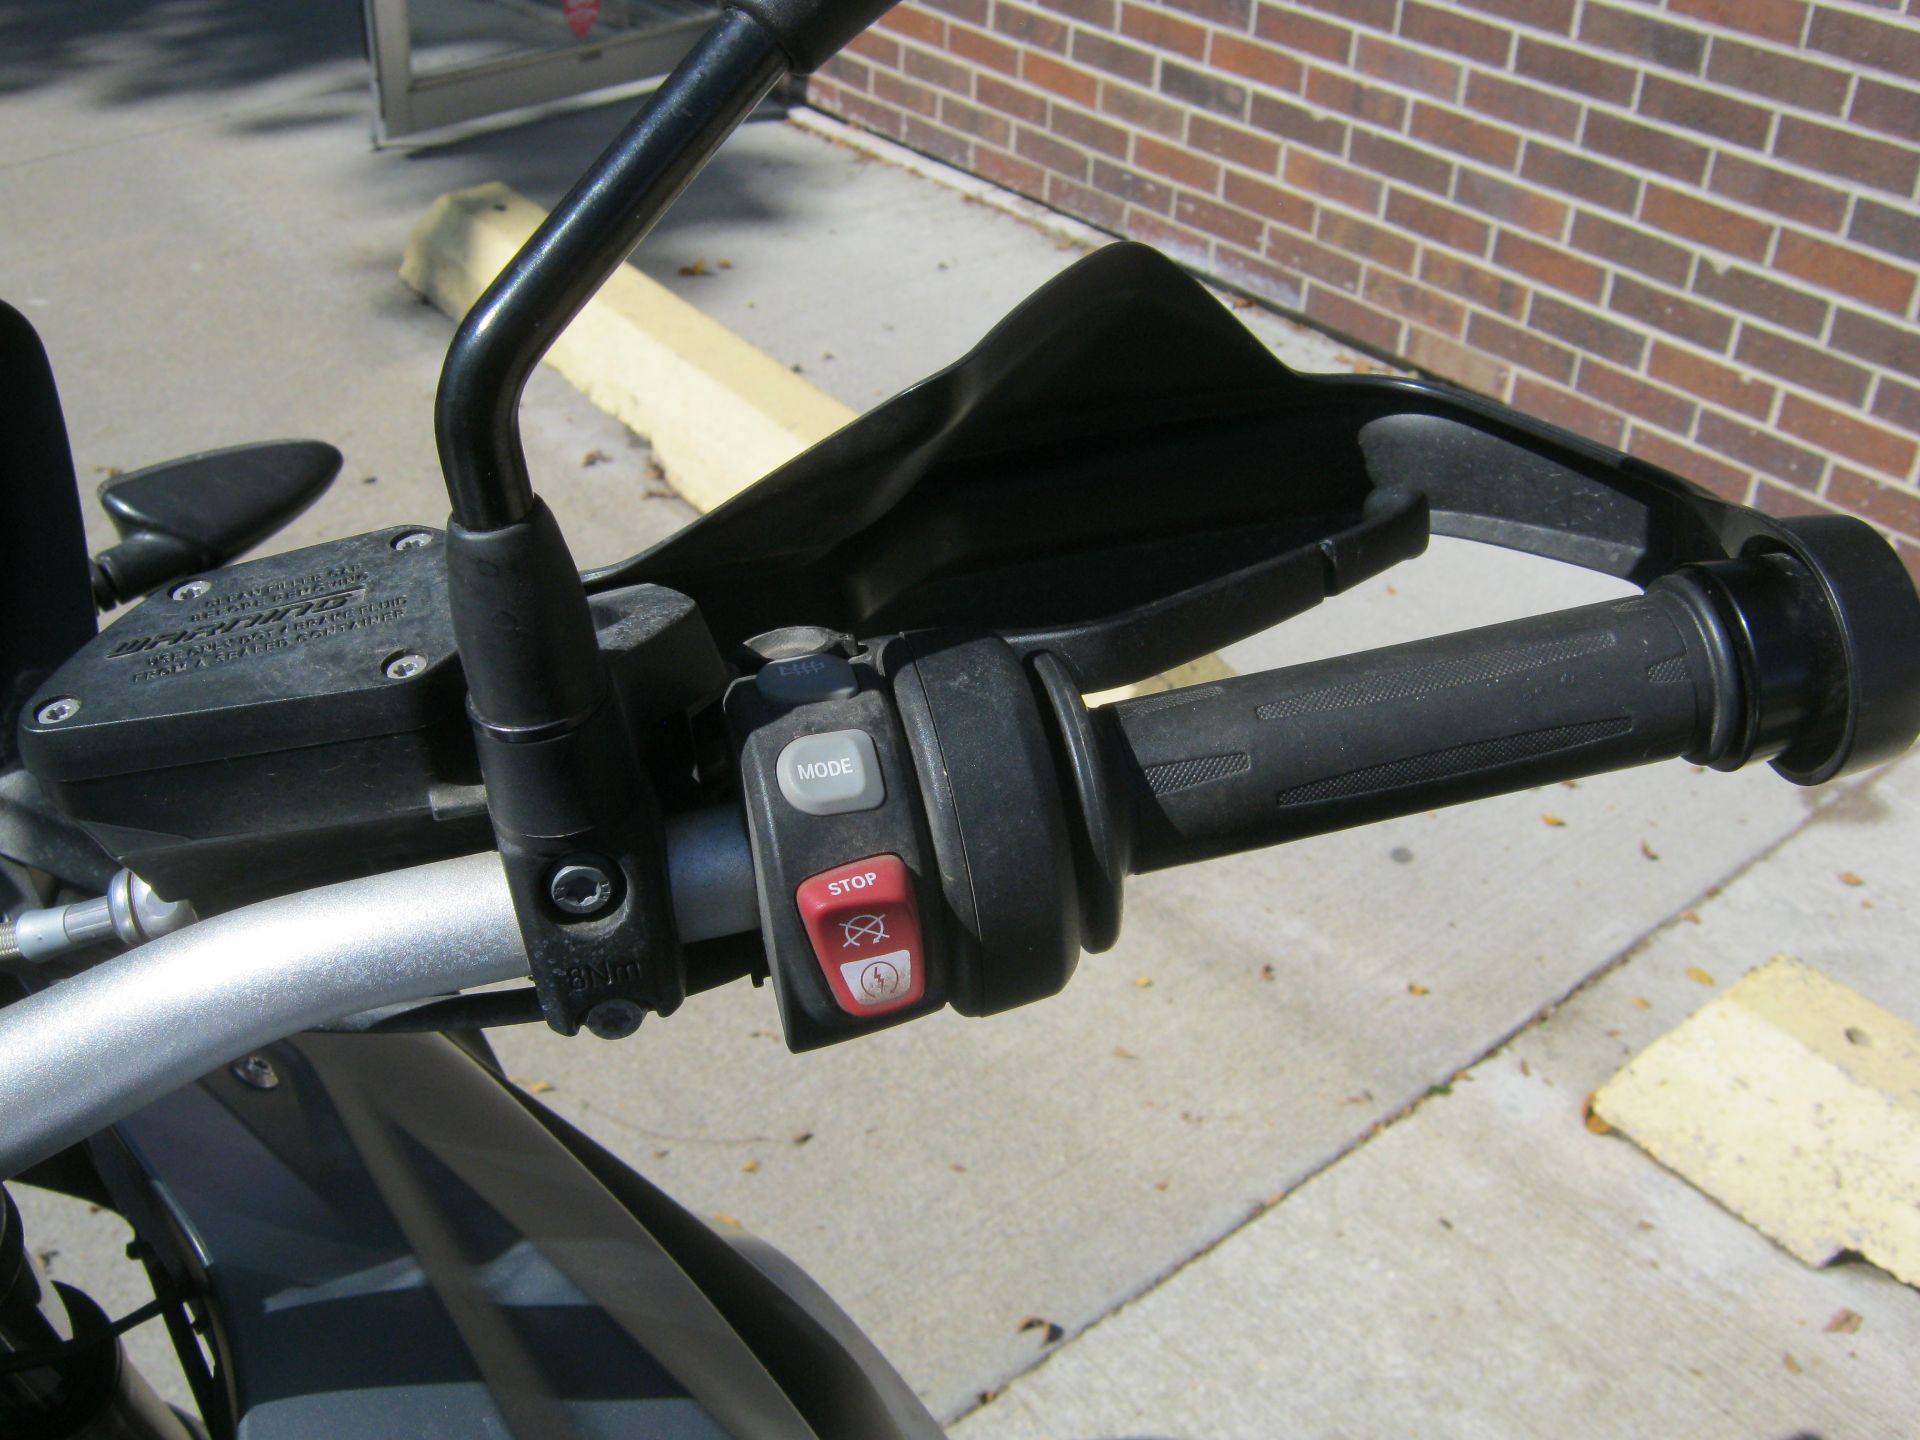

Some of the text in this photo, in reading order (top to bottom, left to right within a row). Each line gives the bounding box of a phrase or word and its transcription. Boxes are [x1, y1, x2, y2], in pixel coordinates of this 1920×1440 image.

[107, 589, 358, 659] WARNING
[295, 610, 351, 632] BRAKE
[359, 595, 407, 615] FLUID
[134, 663, 187, 682] FROM
[216, 638, 288, 662] SEALED
[296, 607, 405, 642] CONTAINER
[797, 757, 853, 781] MODE
[828, 872, 878, 896] STOP
